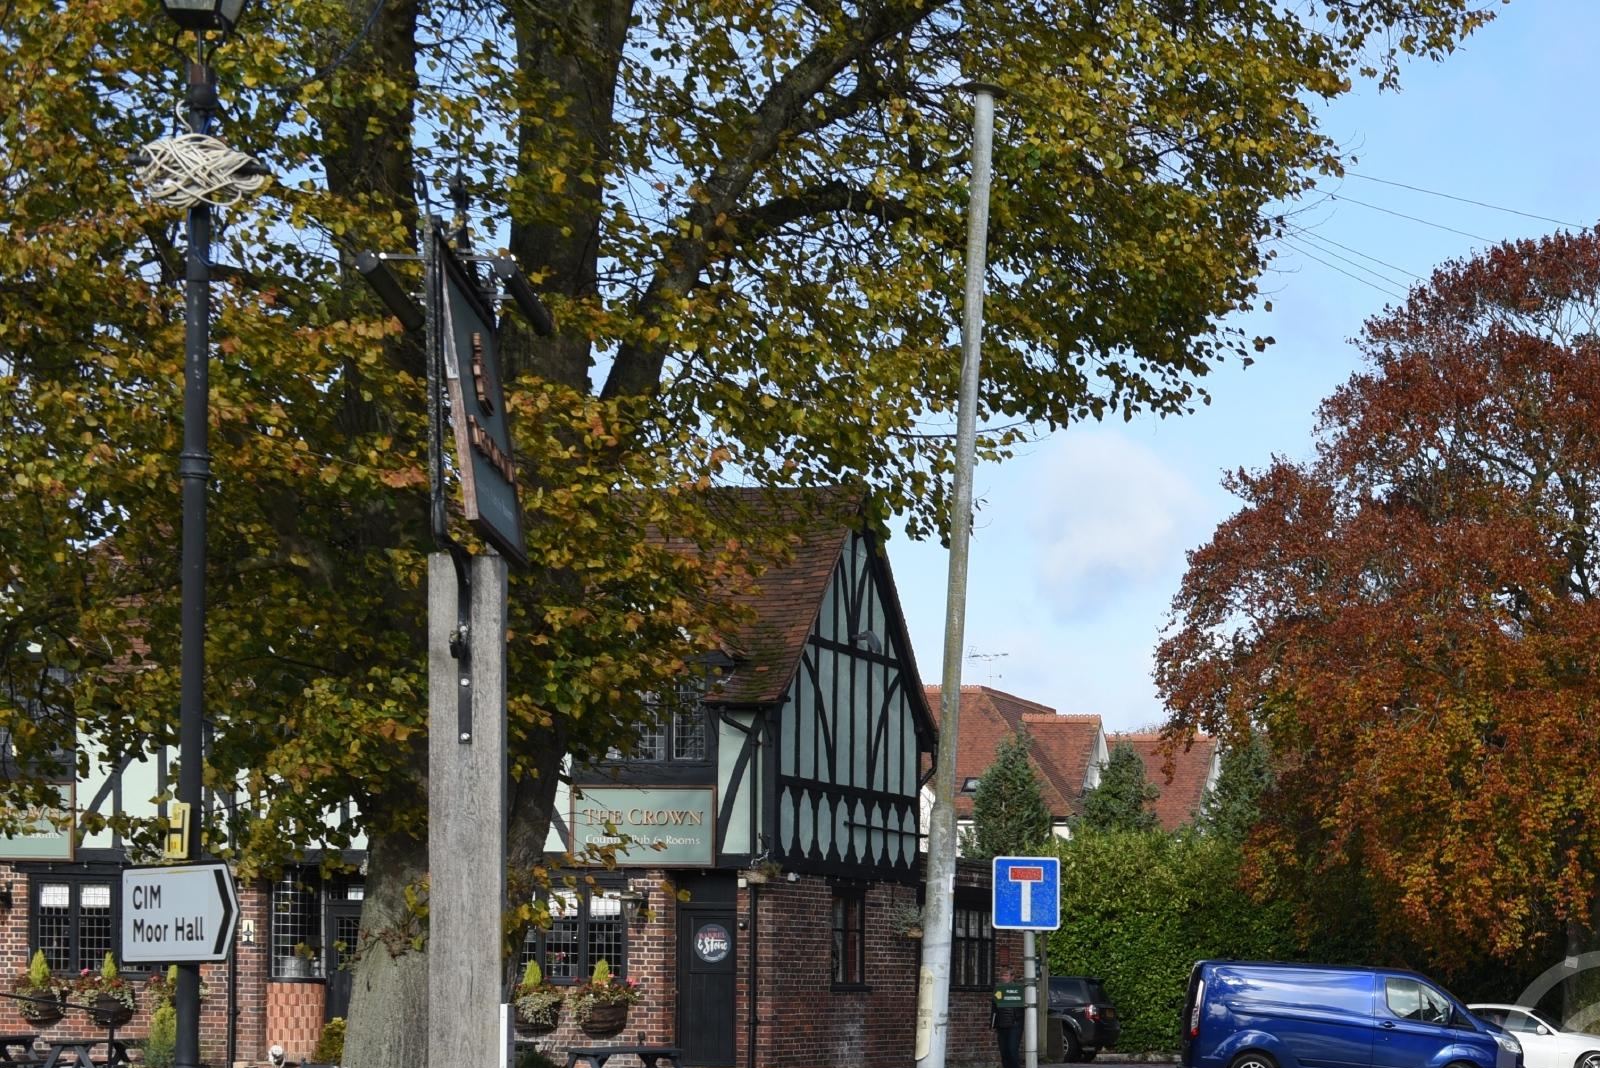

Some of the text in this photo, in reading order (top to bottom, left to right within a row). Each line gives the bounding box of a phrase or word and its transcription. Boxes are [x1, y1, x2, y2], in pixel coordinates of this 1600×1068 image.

[583, 807, 704, 826] THE CROWN
[631, 834, 650, 845] Pub
[666, 835, 701, 845] Rooms
[132, 885, 162, 910] CIM
[132, 916, 204, 943] Moor Hall
